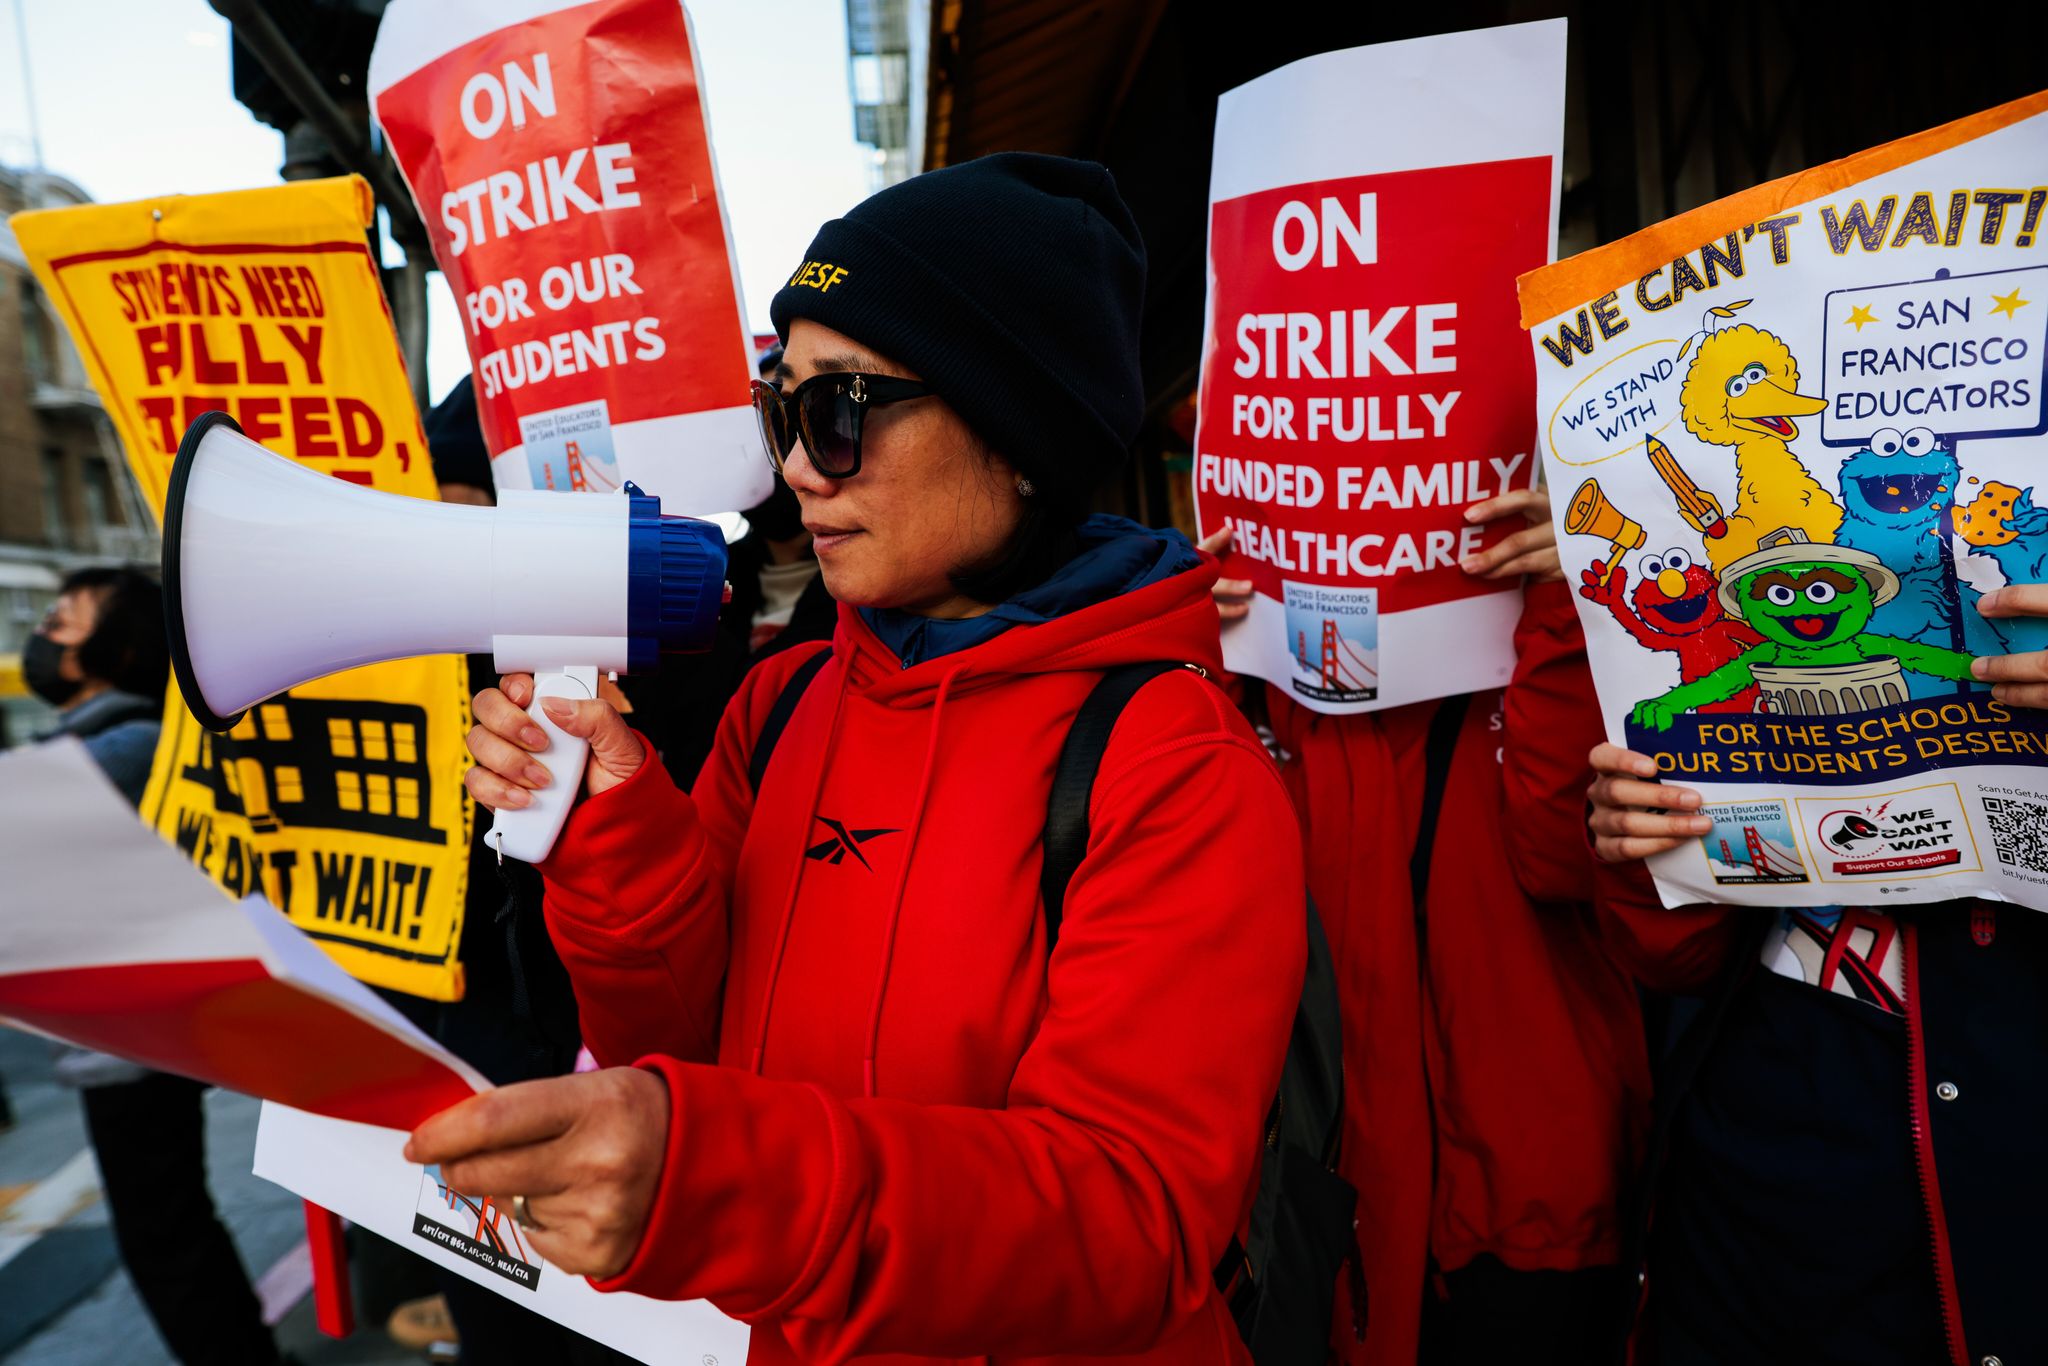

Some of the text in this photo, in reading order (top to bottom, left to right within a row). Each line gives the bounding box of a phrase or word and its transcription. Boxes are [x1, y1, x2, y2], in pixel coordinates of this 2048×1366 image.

[460, 52, 557, 140] ON
[441, 142, 641, 257] STRIKE
[1272, 192, 1378, 272] ON
[239, 266, 325, 318] NEED
[465, 253, 643, 336] FOR OUR
[790, 261, 849, 293] UESF
[1540, 186, 2048, 369] WE CAN'T WAIT!
[1896, 297, 1970, 329] SAN
[479, 317, 666, 399] STUDENTS
[1233, 302, 1458, 379] STRIKE
[1841, 337, 2028, 377] FRANCISCO
[1232, 390, 1462, 442] FOR FULLY
[1562, 358, 1673, 430] WE STAND
[1835, 379, 2031, 420] EDUCATORS
[1595, 398, 1657, 442] WITH
[1200, 453, 1527, 510] FUNDED FAMILY
[1224, 516, 1486, 577] HEALTHCARE
[1698, 700, 2012, 746] FOR THE SCHOOLS
[1655, 751, 1722, 773] OUR
[1728, 744, 1908, 774] STUDENTS
[1731, 804, 1781, 815] EDUCATORS
[1977, 784, 2001, 793] Scan
[2002, 787, 2013, 795] to
[2014, 788, 2032, 797] Get
[1714, 813, 1781, 824] SAN FRANCISCO
[1881, 820, 1952, 839] CAN'T
[1890, 808, 1936, 824] WE
[1845, 853, 1947, 871] Support Our Schools
[1888, 834, 1953, 851] WAIT
[312, 851, 433, 941] WAIT!
[421, 1223, 530, 1281] AFT/CFT #61, AFL-CIO, NEA/CTA
